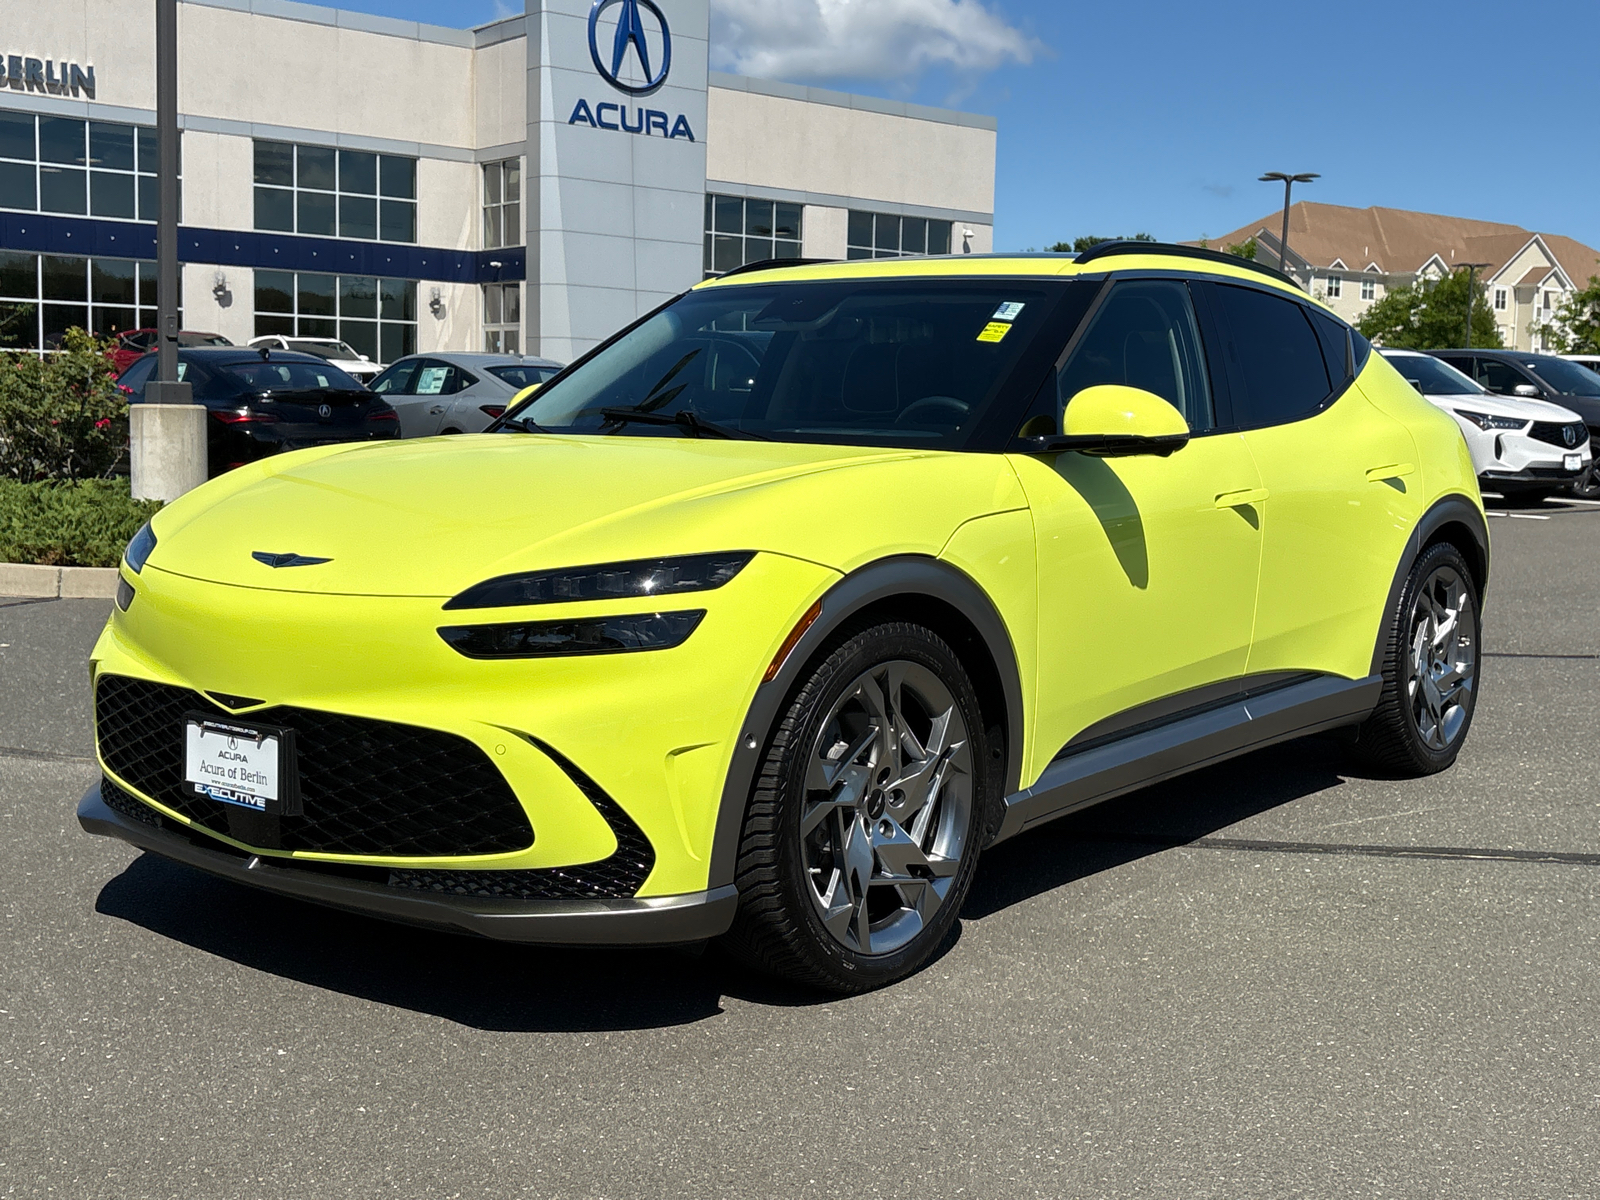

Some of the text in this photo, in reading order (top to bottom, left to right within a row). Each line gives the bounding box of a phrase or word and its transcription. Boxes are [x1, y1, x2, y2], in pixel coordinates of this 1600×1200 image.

[568, 99, 695, 142] ACURA
[218, 750, 248, 763] ACURA
[200, 760, 268, 786] Acura of Berlin
[194, 783, 266, 807] EXECUTIVE
